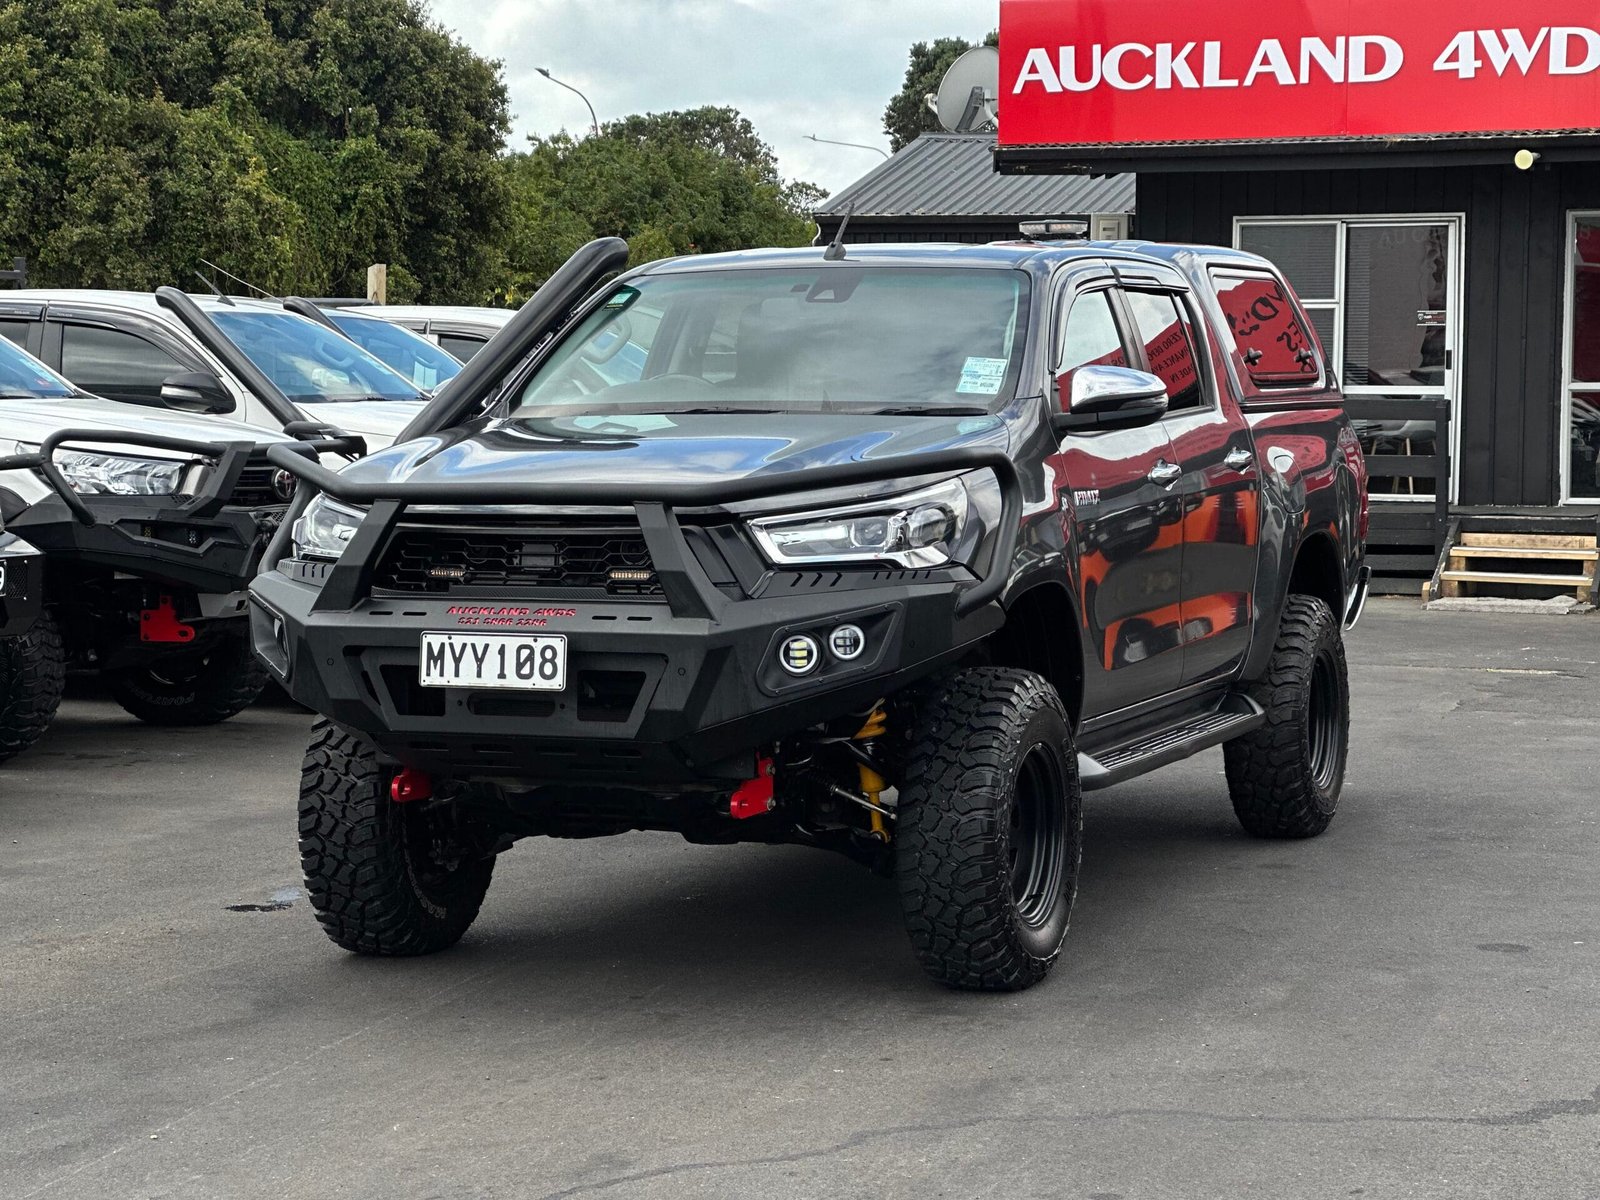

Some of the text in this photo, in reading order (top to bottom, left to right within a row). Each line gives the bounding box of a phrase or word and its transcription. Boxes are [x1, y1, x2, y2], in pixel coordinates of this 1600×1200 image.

[1012, 26, 1600, 94] AUCKLAND 4WD
[447, 606, 577, 617] AUCKLAND 4WDS
[426, 641, 558, 680] MYY108
